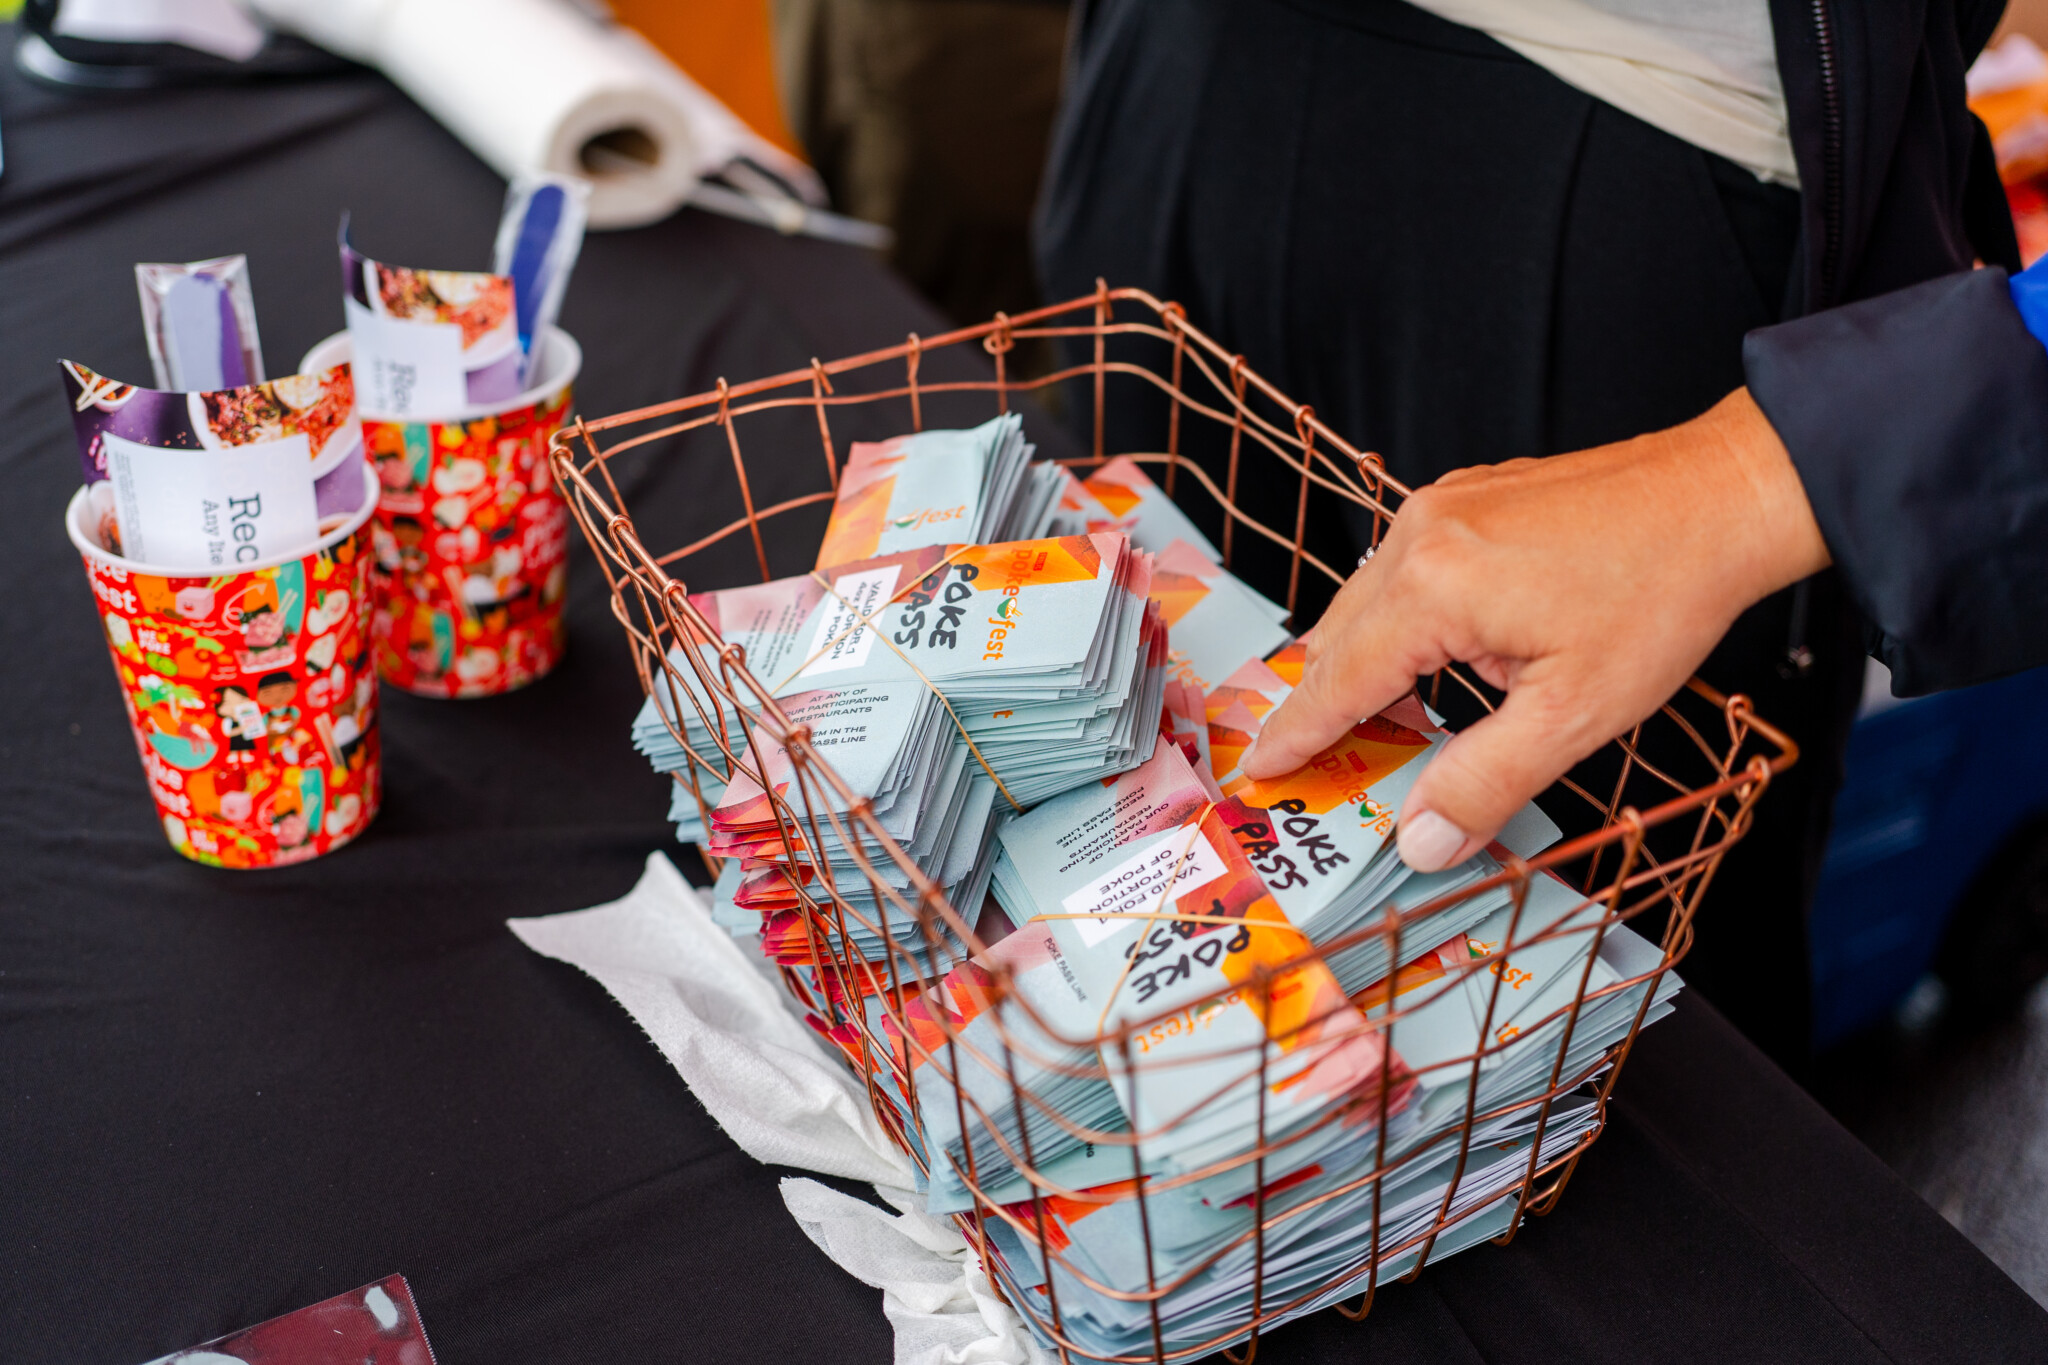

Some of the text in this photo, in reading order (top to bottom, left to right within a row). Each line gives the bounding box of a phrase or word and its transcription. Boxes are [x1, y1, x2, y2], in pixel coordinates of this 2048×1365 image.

[862, 580, 883, 617] VALID
[928, 563, 979, 650] POKE
[982, 617, 1017, 661] fest
[784, 695, 889, 717] OUR PARTICIPATING
[792, 706, 872, 724] RESTAURANTS
[809, 695, 824, 703] AT
[825, 691, 850, 699] ANY
[811, 738, 838, 747] PASS
[841, 735, 867, 744] LINE
[844, 726, 867, 734] THE
[1056, 786, 1145, 845] POKE PASS LINE
[1059, 803, 1169, 873] OUR PARTICIPATING
[1061, 793, 1145, 848] REDEEM IN THE
[1069, 804, 1152, 859] RESTAURANTS
[1268, 799, 1351, 876] POKE
[1088, 824, 1148, 865] AT ANY OF
[1231, 822, 1309, 889] PASS
[1089, 869, 1164, 914] PORTION
[1099, 849, 1173, 895] OF POKE
[1043, 937, 1062, 960] POKE
[1131, 924, 1251, 1004] POKE
